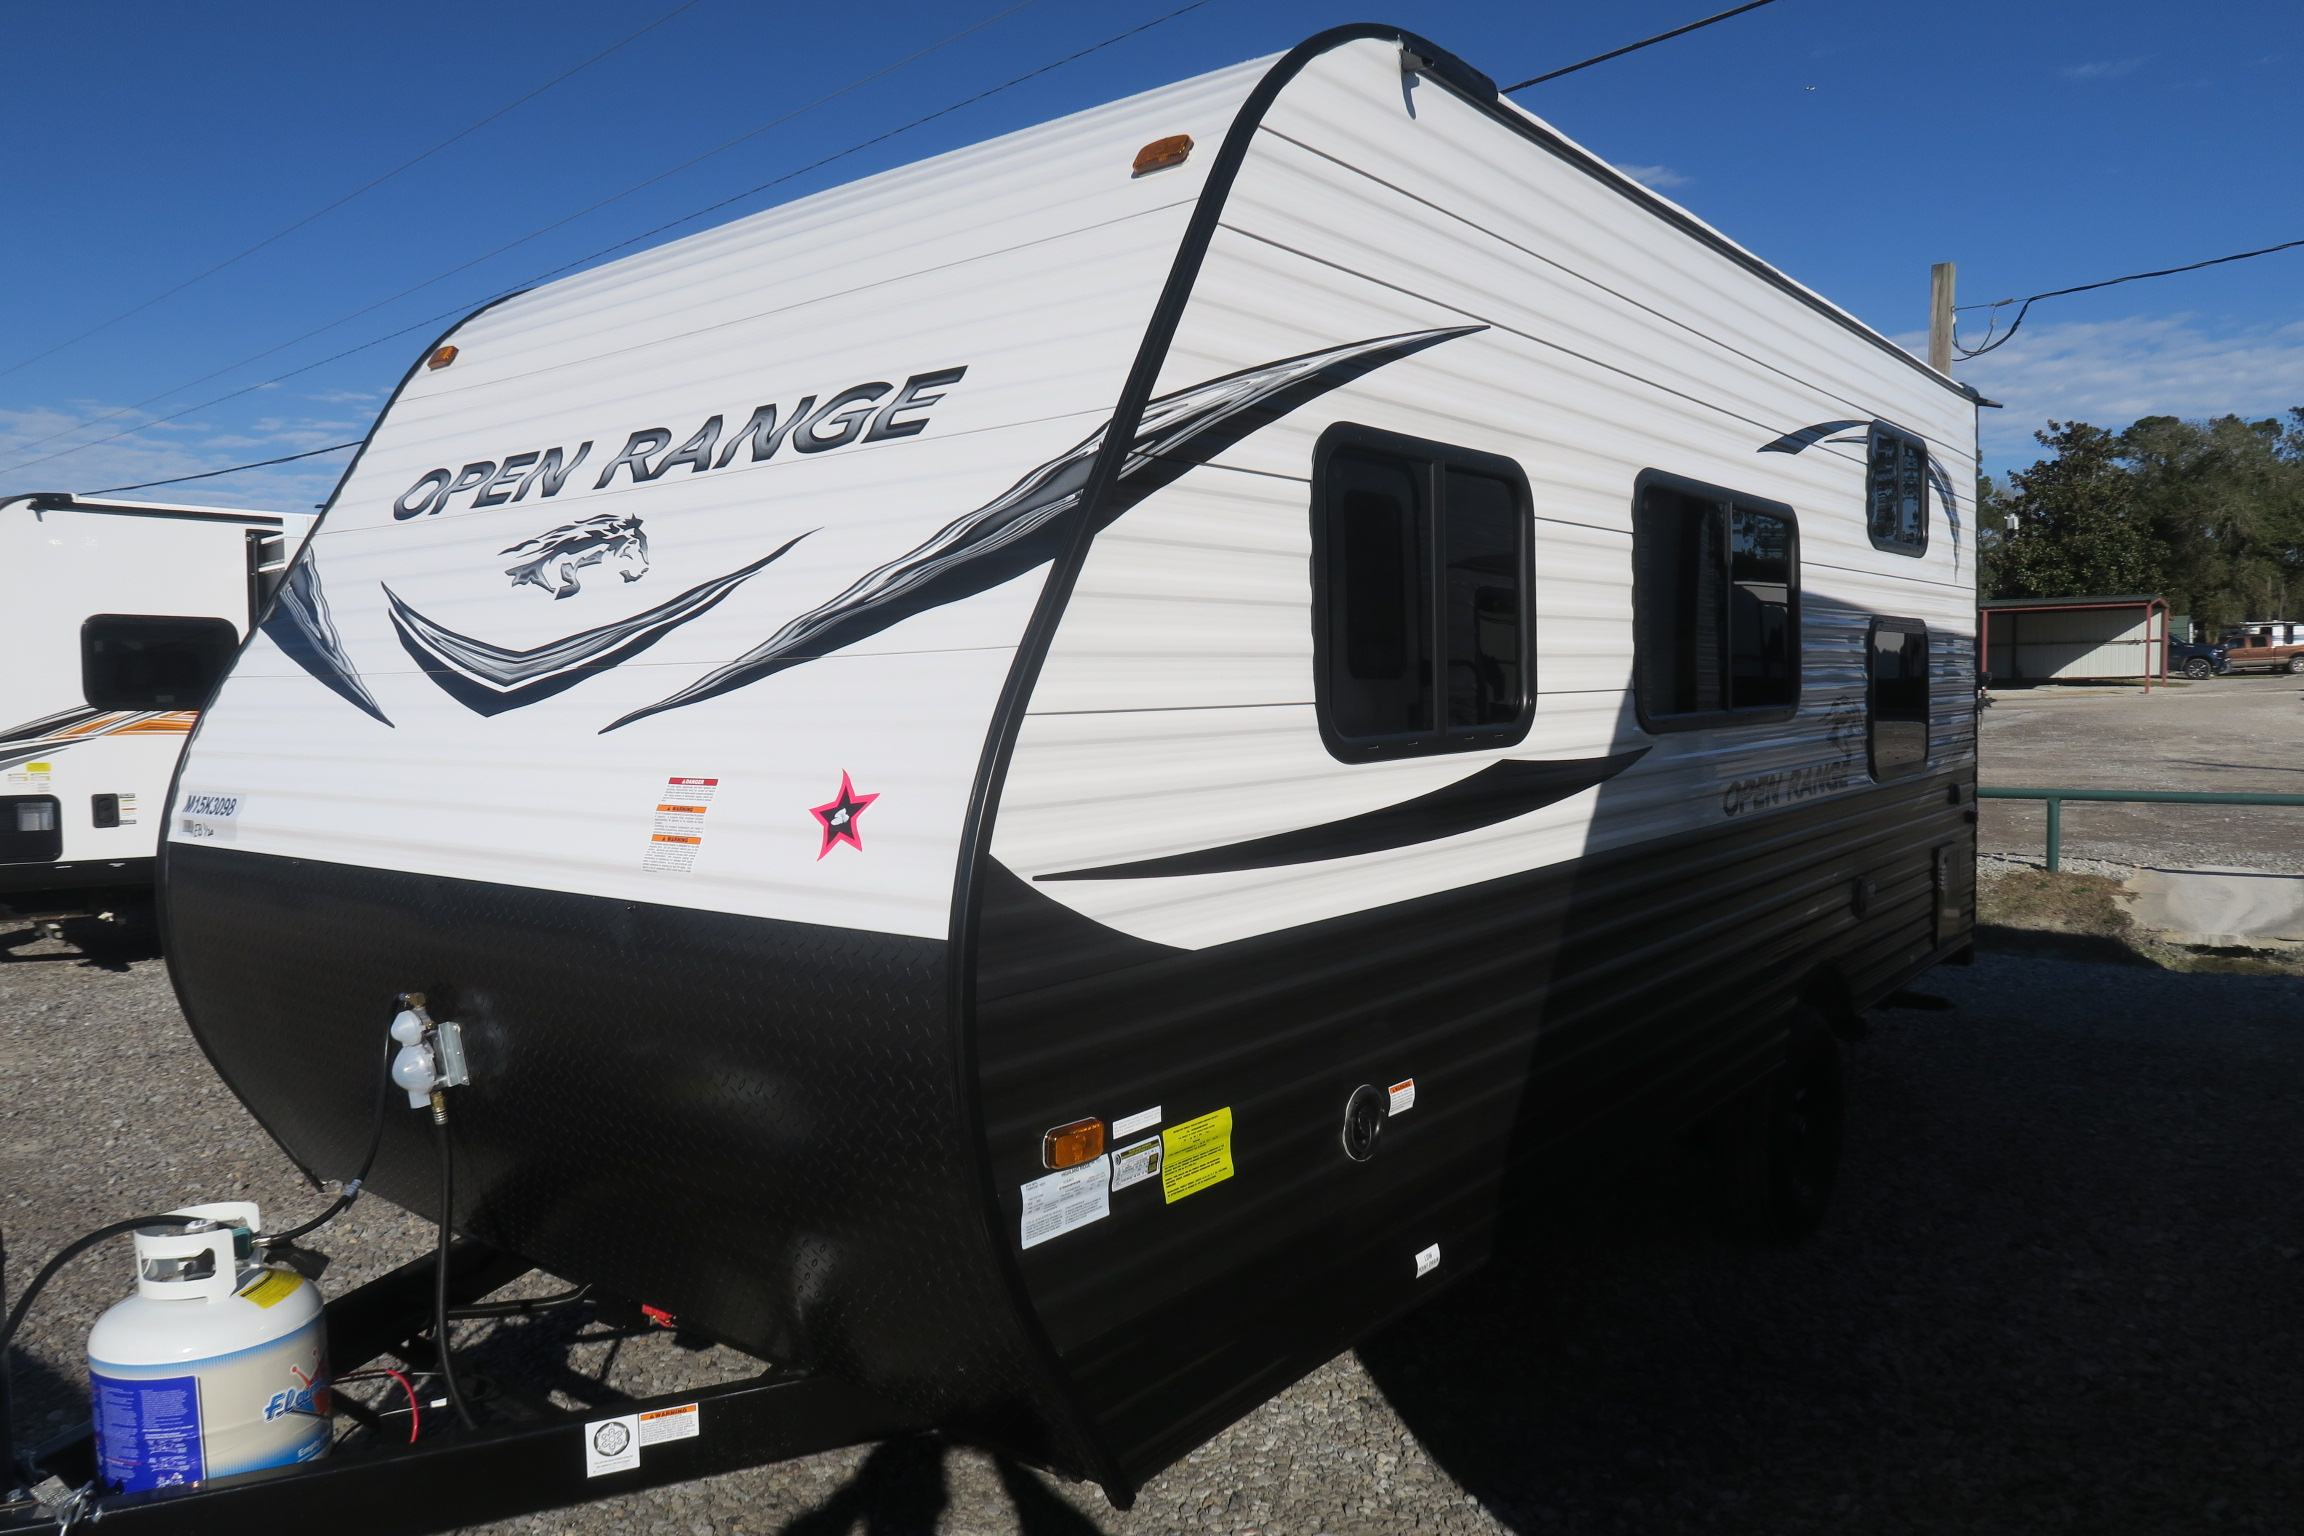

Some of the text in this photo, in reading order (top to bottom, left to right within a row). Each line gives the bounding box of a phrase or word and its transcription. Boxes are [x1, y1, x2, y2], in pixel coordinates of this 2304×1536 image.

[393, 365, 969, 521] OPEN RANGE
[182, 795, 238, 817] M15K3098
[1723, 760, 1851, 816] OPEN RANGE
[655, 1407, 688, 1419] WARNING
